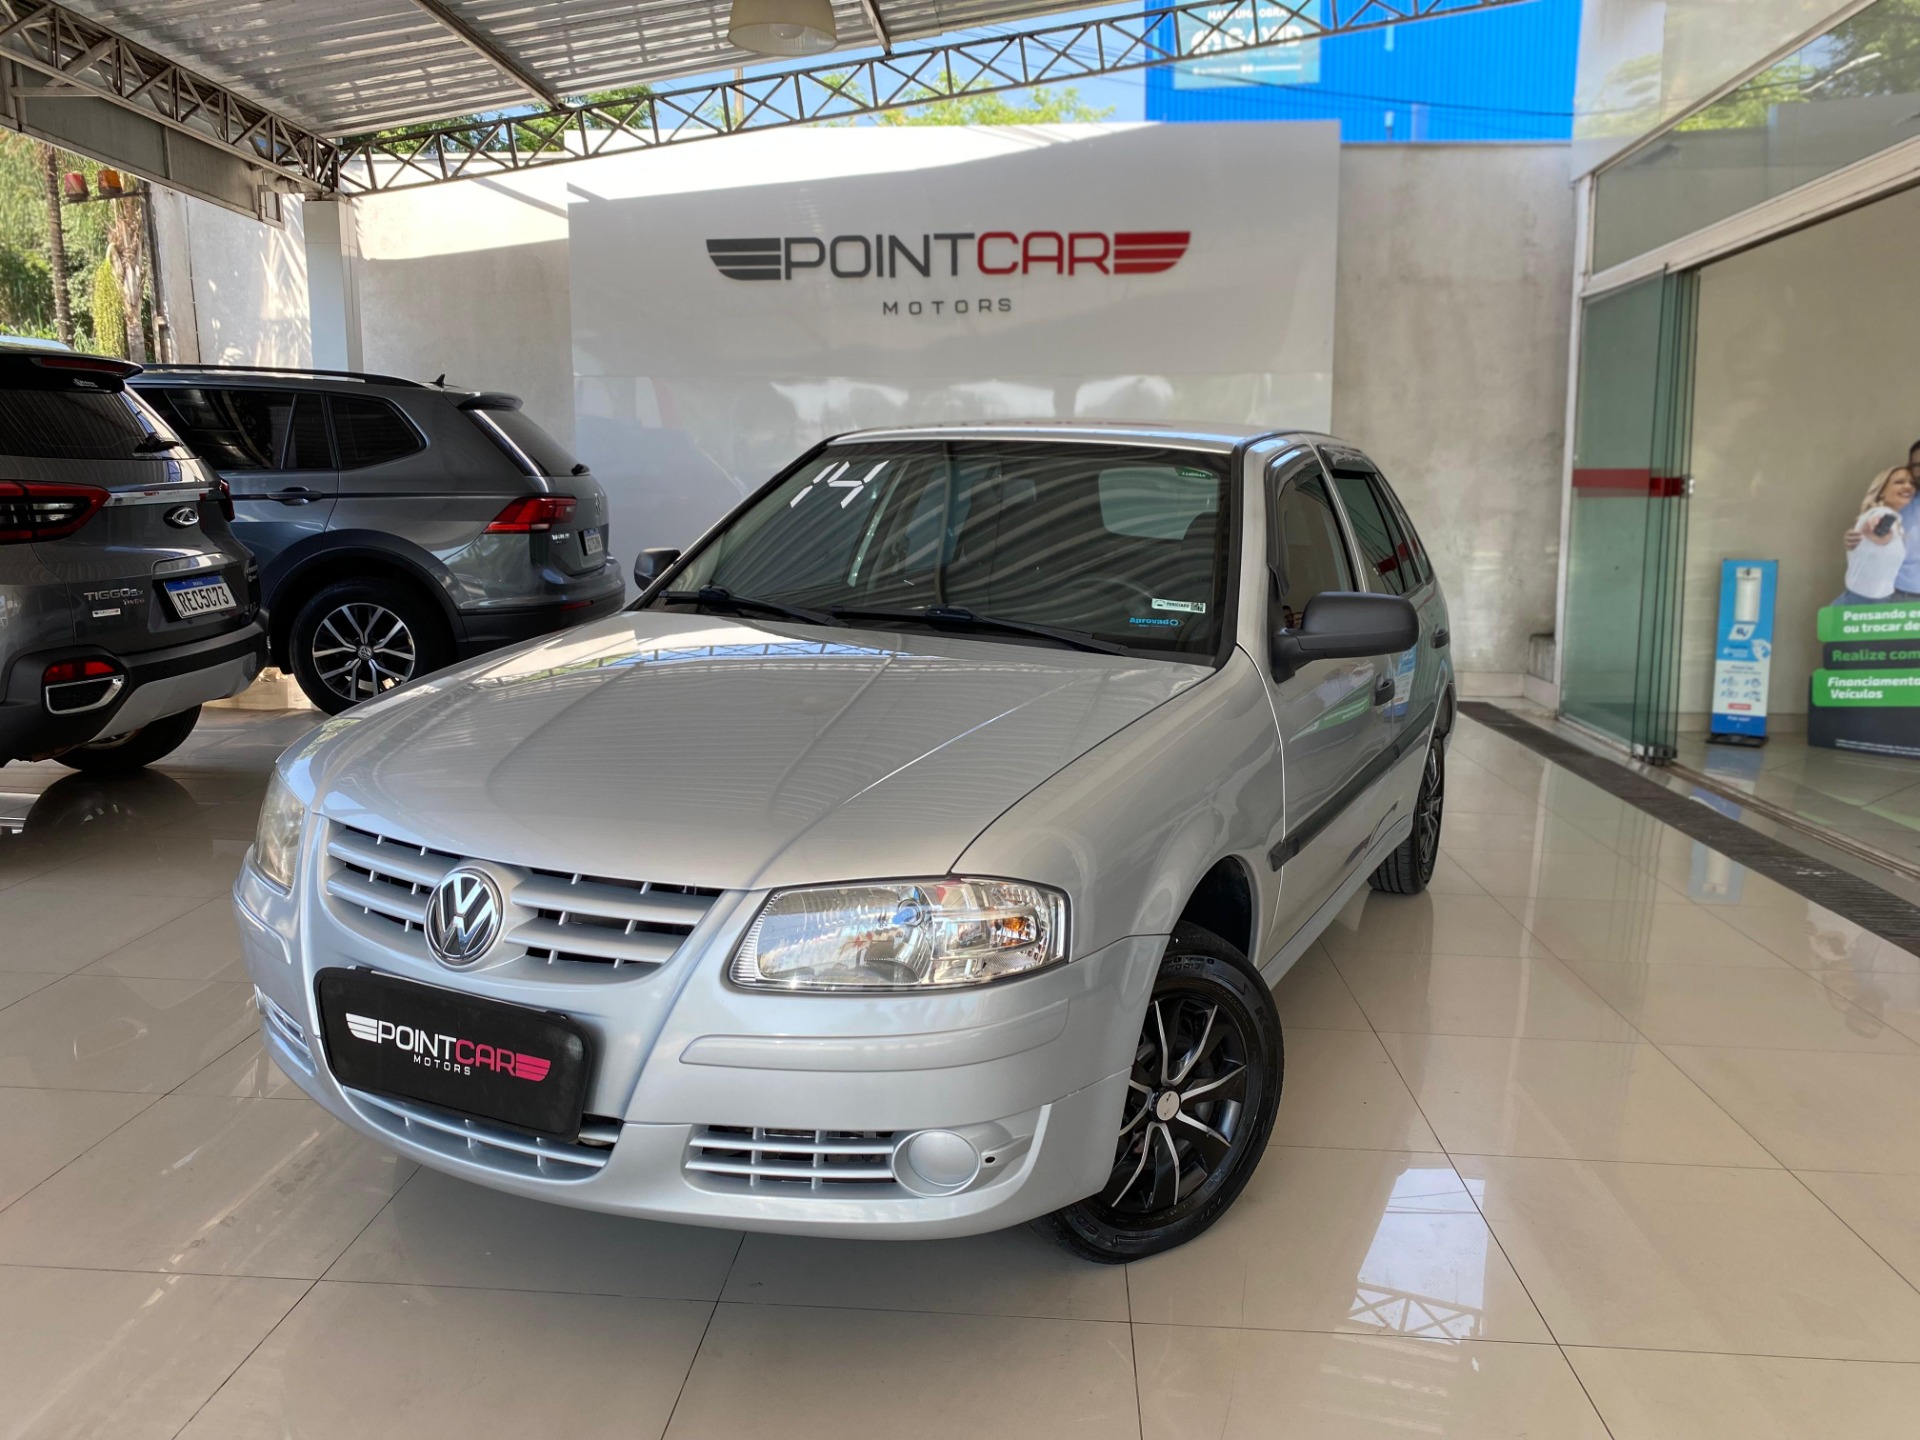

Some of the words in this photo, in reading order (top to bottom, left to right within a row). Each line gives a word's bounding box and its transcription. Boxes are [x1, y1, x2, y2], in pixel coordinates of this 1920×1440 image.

[784, 231, 1110, 280] POINTCAR
[883, 298, 1012, 315] MOTORS
[176, 585, 229, 613] REC5C73
[1843, 609, 1906, 621] Pensando
[1843, 624, 1860, 633] ou
[1862, 622, 1902, 633] trocar
[1832, 649, 1887, 661] Realize
[1831, 688, 1883, 700] Veículos
[378, 1020, 516, 1077] POINTCAR
[413, 1054, 471, 1076] MOTORS
